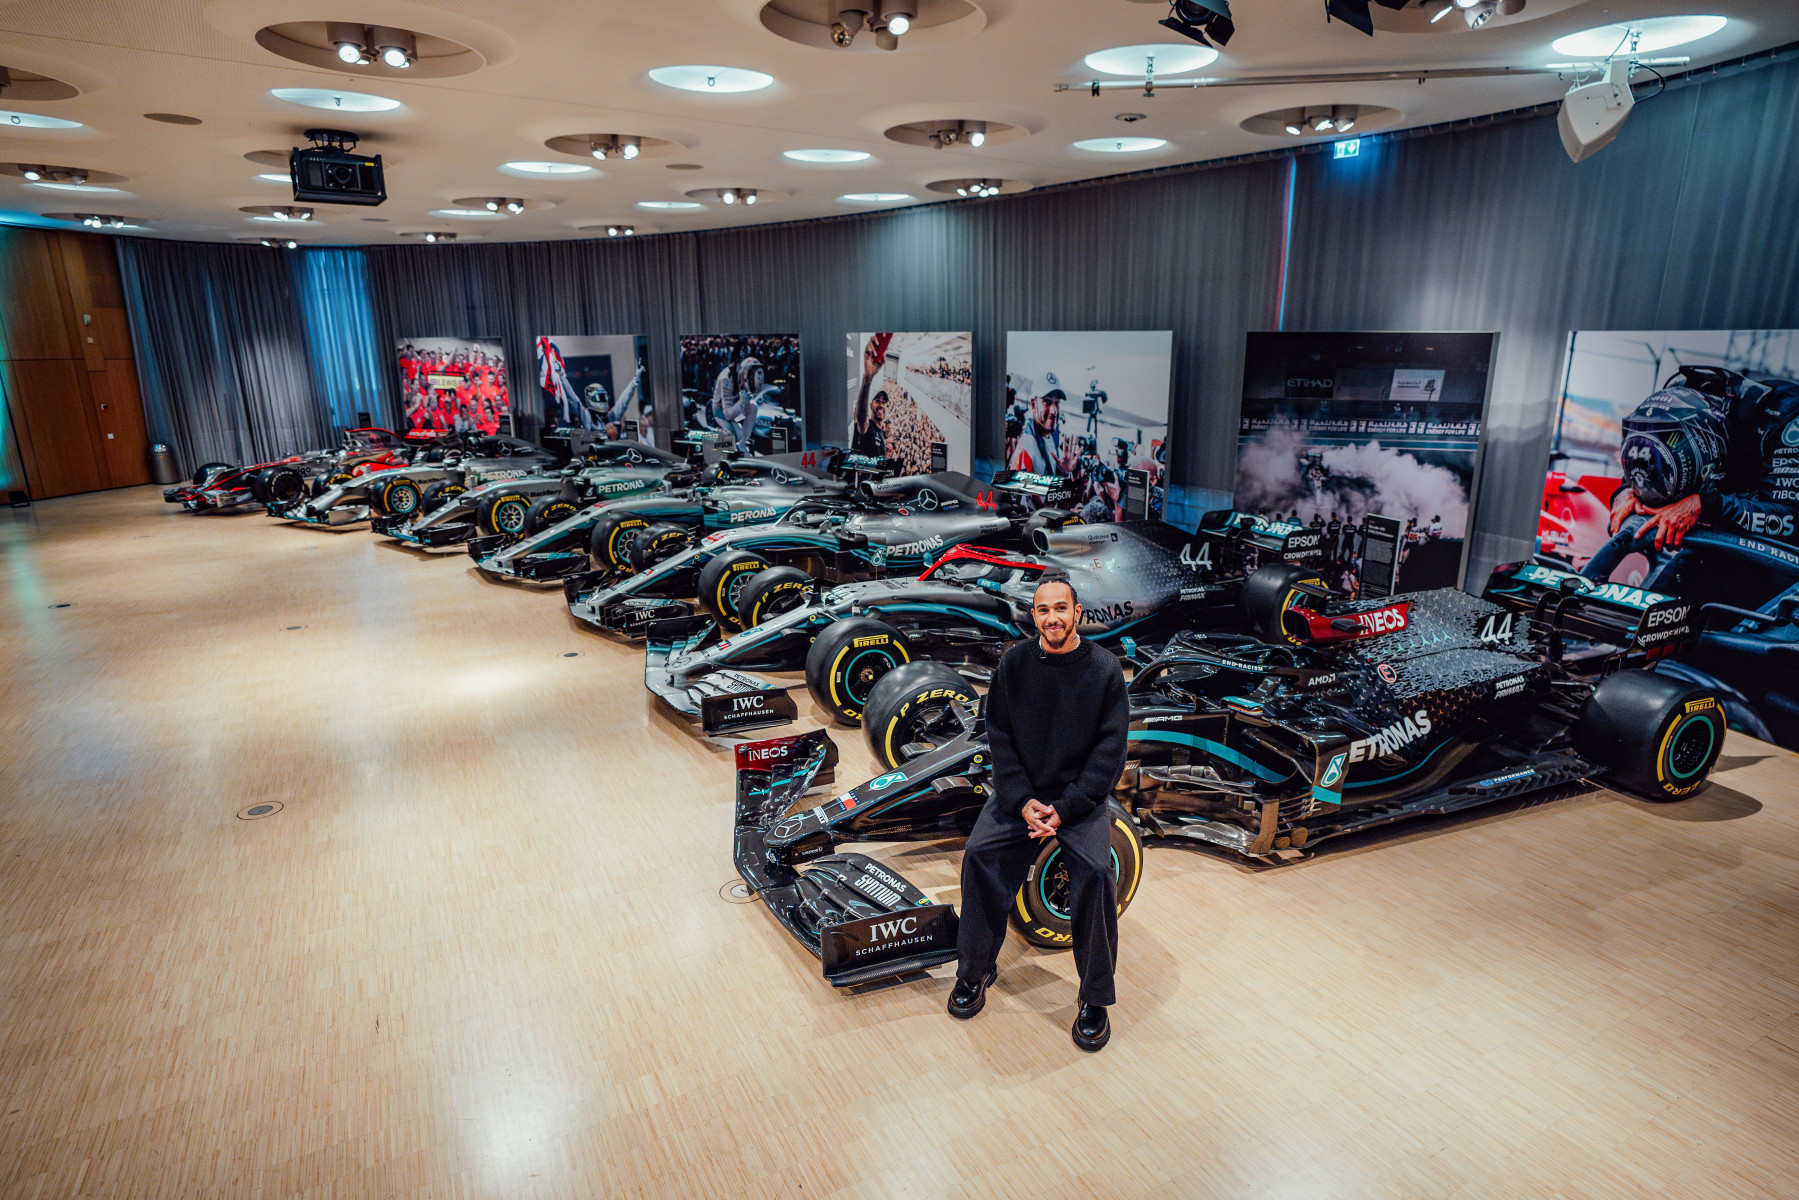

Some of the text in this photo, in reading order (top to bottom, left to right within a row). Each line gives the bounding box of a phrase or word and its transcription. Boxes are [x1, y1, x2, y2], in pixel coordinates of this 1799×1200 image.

[438, 379, 458, 387] LEWIS
[1287, 378, 1333, 388] ETIHAD
[801, 452, 816, 468] 44
[1628, 446, 1652, 461] 44
[599, 479, 645, 494] PETRONAS
[976, 490, 997, 511] 44
[1047, 490, 1072, 502] EPSON
[886, 534, 944, 557] PETRONAS
[1288, 534, 1320, 549] EPSON
[1739, 538, 1766, 552] END
[1180, 542, 1213, 572] 44
[732, 560, 760, 572] PIRELLI
[762, 582, 813, 603] P ZERO
[634, 609, 656, 621] IWC
[1079, 600, 1134, 626] TRONAS
[1646, 605, 1692, 628] EPSON
[1480, 612, 1514, 645] 44
[853, 634, 889, 648] PIRELLI
[1222, 659, 1264, 672] END RACISM
[733, 673, 760, 687] PETRONAS
[1308, 675, 1329, 687] AMD
[1495, 675, 1525, 690] PETRONAS
[732, 695, 764, 711] IWC
[900, 688, 970, 718] P ZERO
[1685, 697, 1715, 714] PIRELLI
[723, 708, 774, 720] SCHAFFHAUSEN
[748, 745, 788, 762] INEOS
[1494, 769, 1535, 783] PERFORMANCE
[864, 862, 907, 893] PETRONAS
[854, 873, 902, 907] SYNTIUM
[869, 916, 918, 943] IWC
[855, 934, 933, 957] SCHAFFHAUSEN
